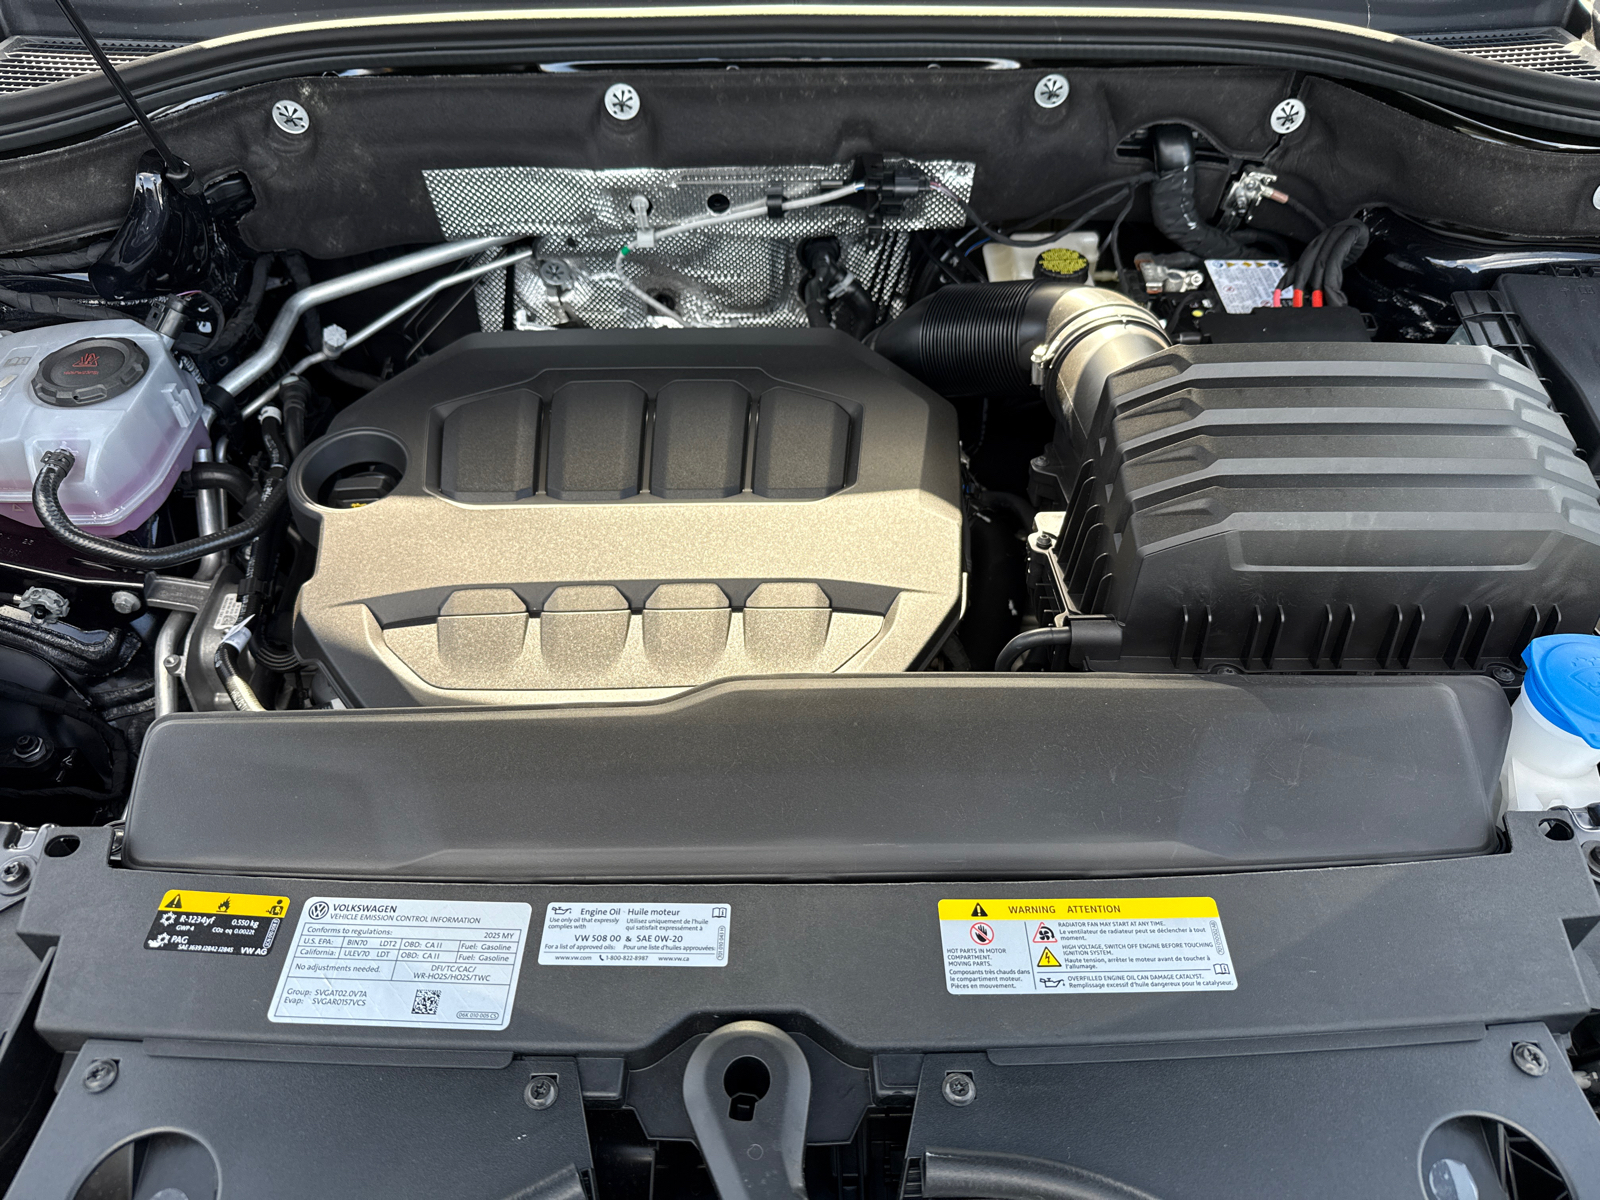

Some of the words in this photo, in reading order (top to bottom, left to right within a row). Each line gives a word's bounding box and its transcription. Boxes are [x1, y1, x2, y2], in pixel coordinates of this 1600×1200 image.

[333, 904, 397, 912] VOLKSWAGEN
[580, 908, 607, 917] Engine
[1008, 906, 1056, 914] WARNING
[1067, 905, 1121, 913] ATTENTION
[179, 915, 216, 926] R-1234yf
[250, 920, 259, 928] kg
[351, 928, 392, 936] regulations:
[287, 988, 312, 997] Group:
[284, 997, 304, 1005] Evap:
